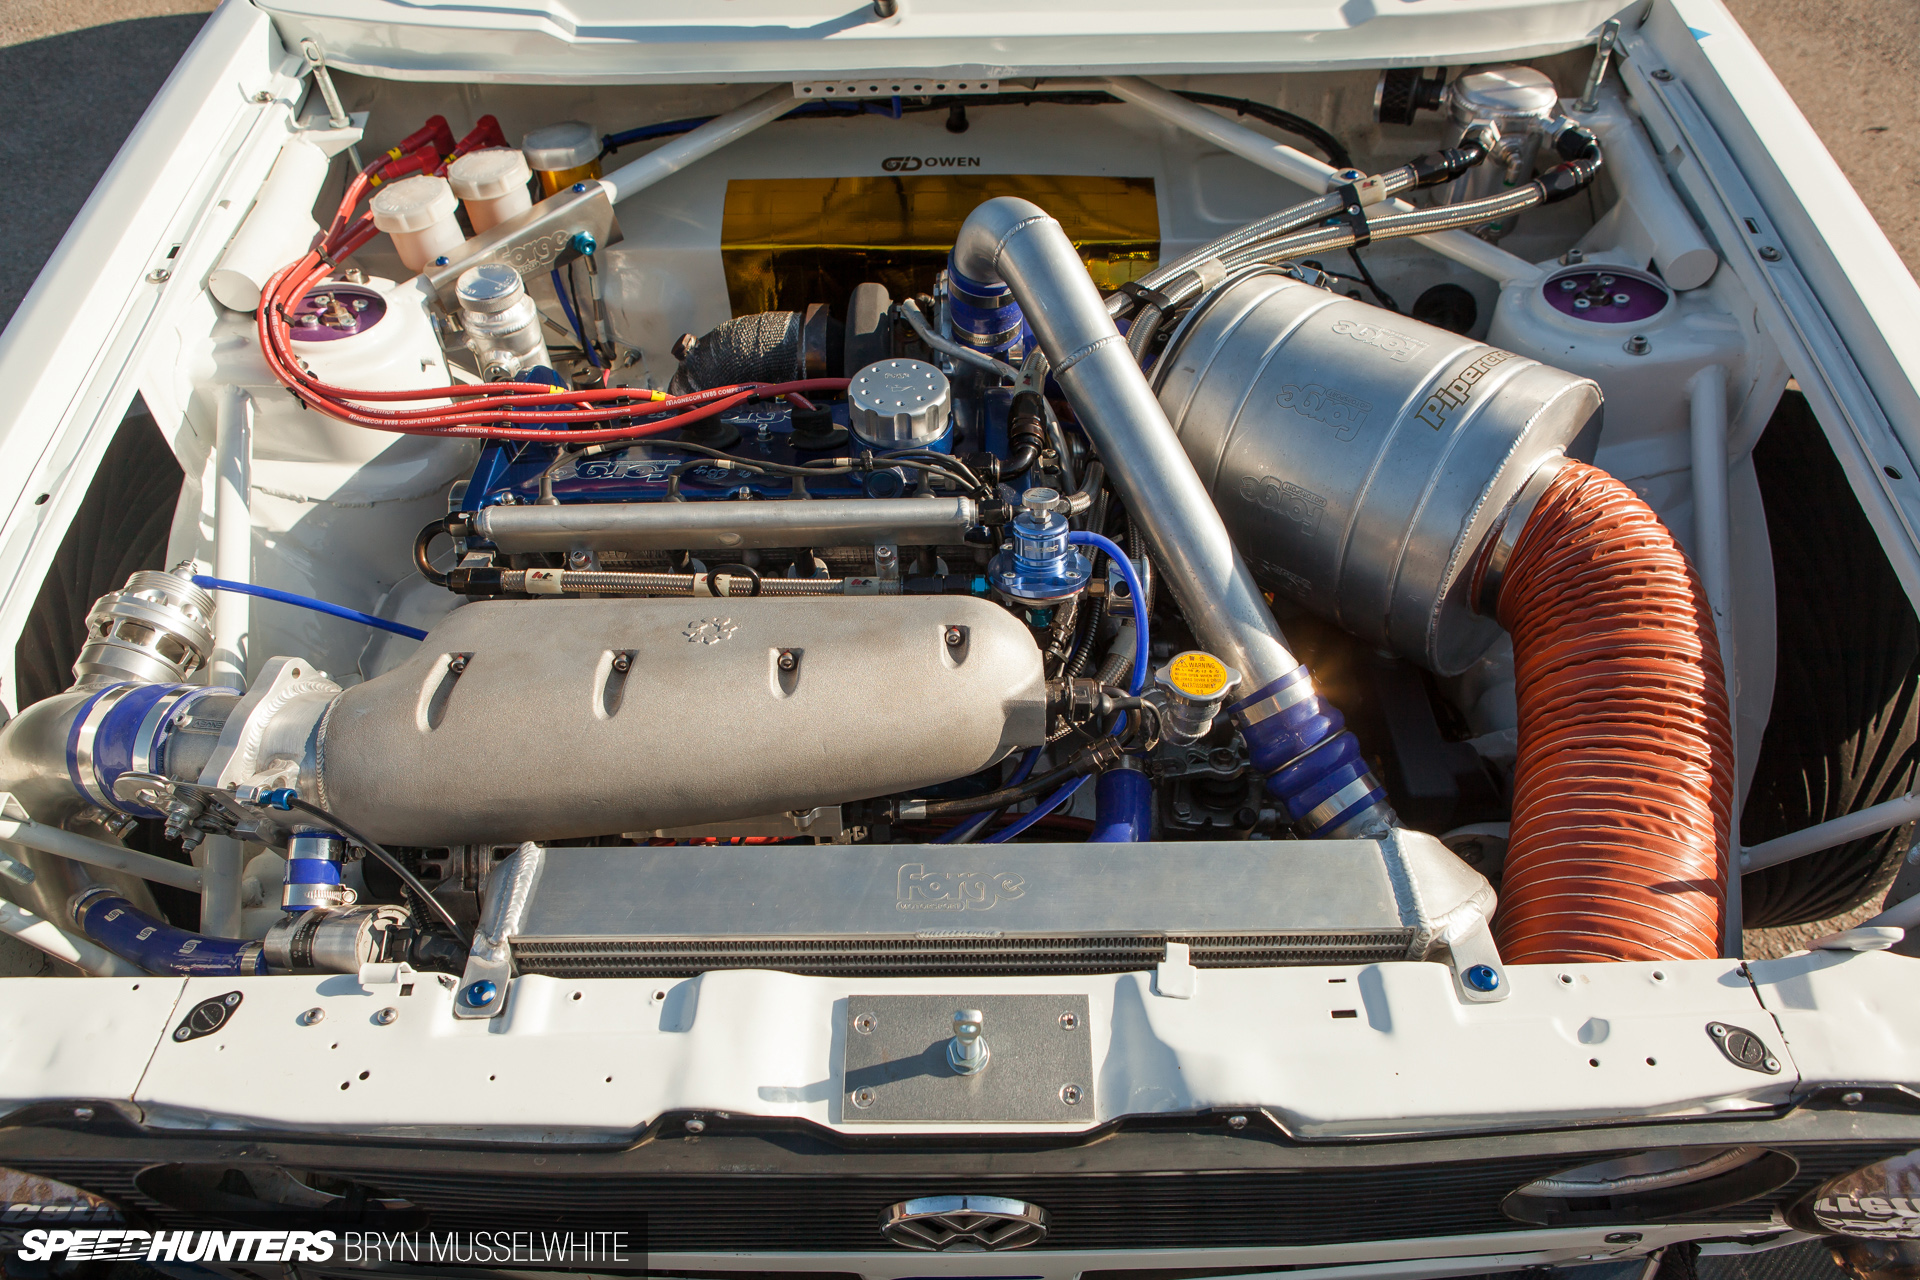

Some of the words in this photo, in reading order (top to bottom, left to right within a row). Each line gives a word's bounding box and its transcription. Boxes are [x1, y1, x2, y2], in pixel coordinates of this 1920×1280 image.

[924, 157, 980, 167] OWEN
[666, 394, 702, 406] MAGNECOR
[702, 390, 717, 399] KV85
[1276, 384, 1368, 442] Forge
[348, 413, 383, 425] MAGNECOR
[399, 416, 441, 426] COMPETITION
[1240, 475, 1324, 537] Forge
[897, 863, 1025, 911] Forge
